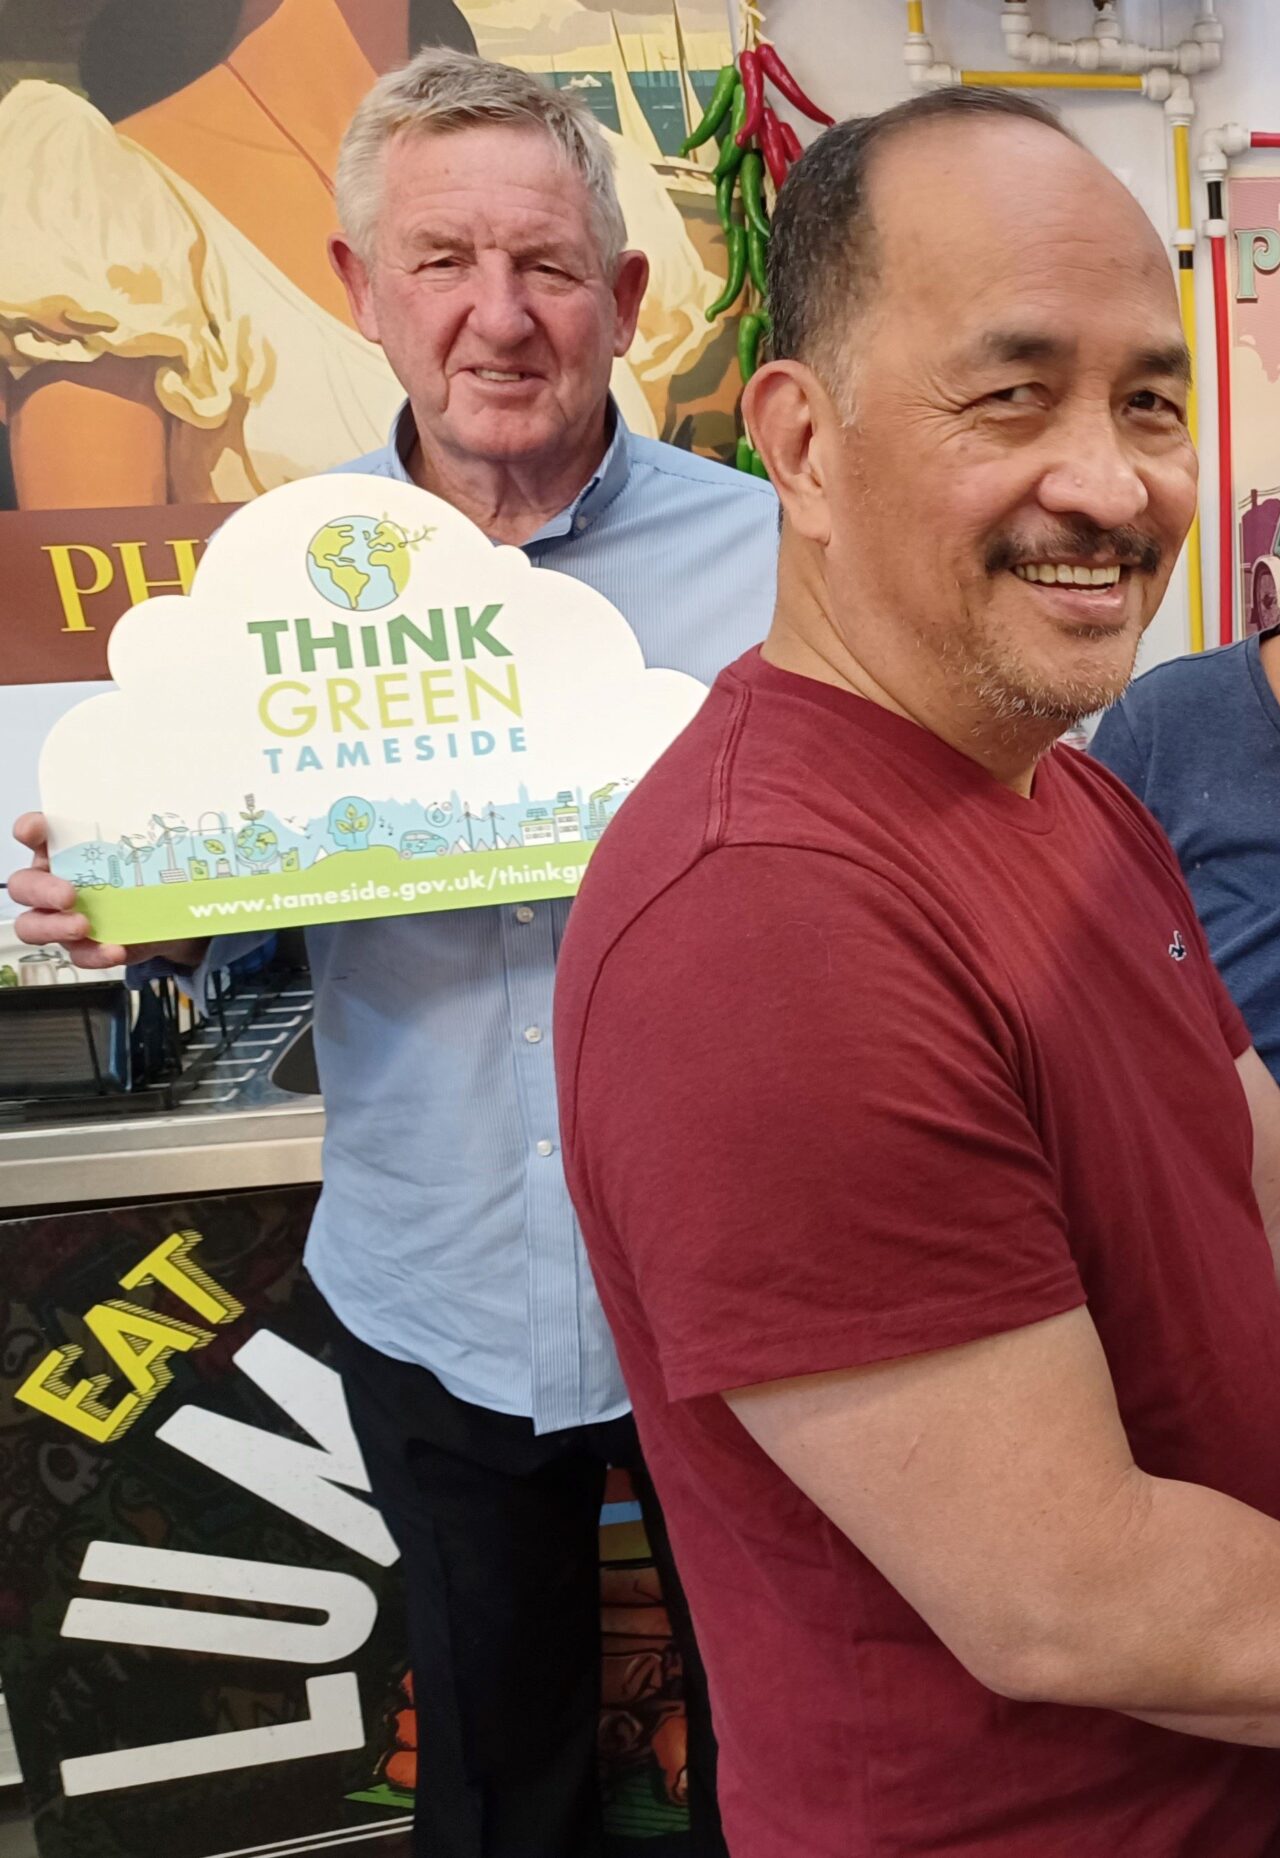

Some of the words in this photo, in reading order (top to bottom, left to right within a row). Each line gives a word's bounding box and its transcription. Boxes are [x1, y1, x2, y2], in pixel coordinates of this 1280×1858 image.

[40, 538, 213, 632] PH
[247, 603, 514, 675] THINK
[258, 663, 523, 738] GREEN
[263, 727, 527, 774] TAMESIDE
[14, 1229, 245, 1443] EAT
